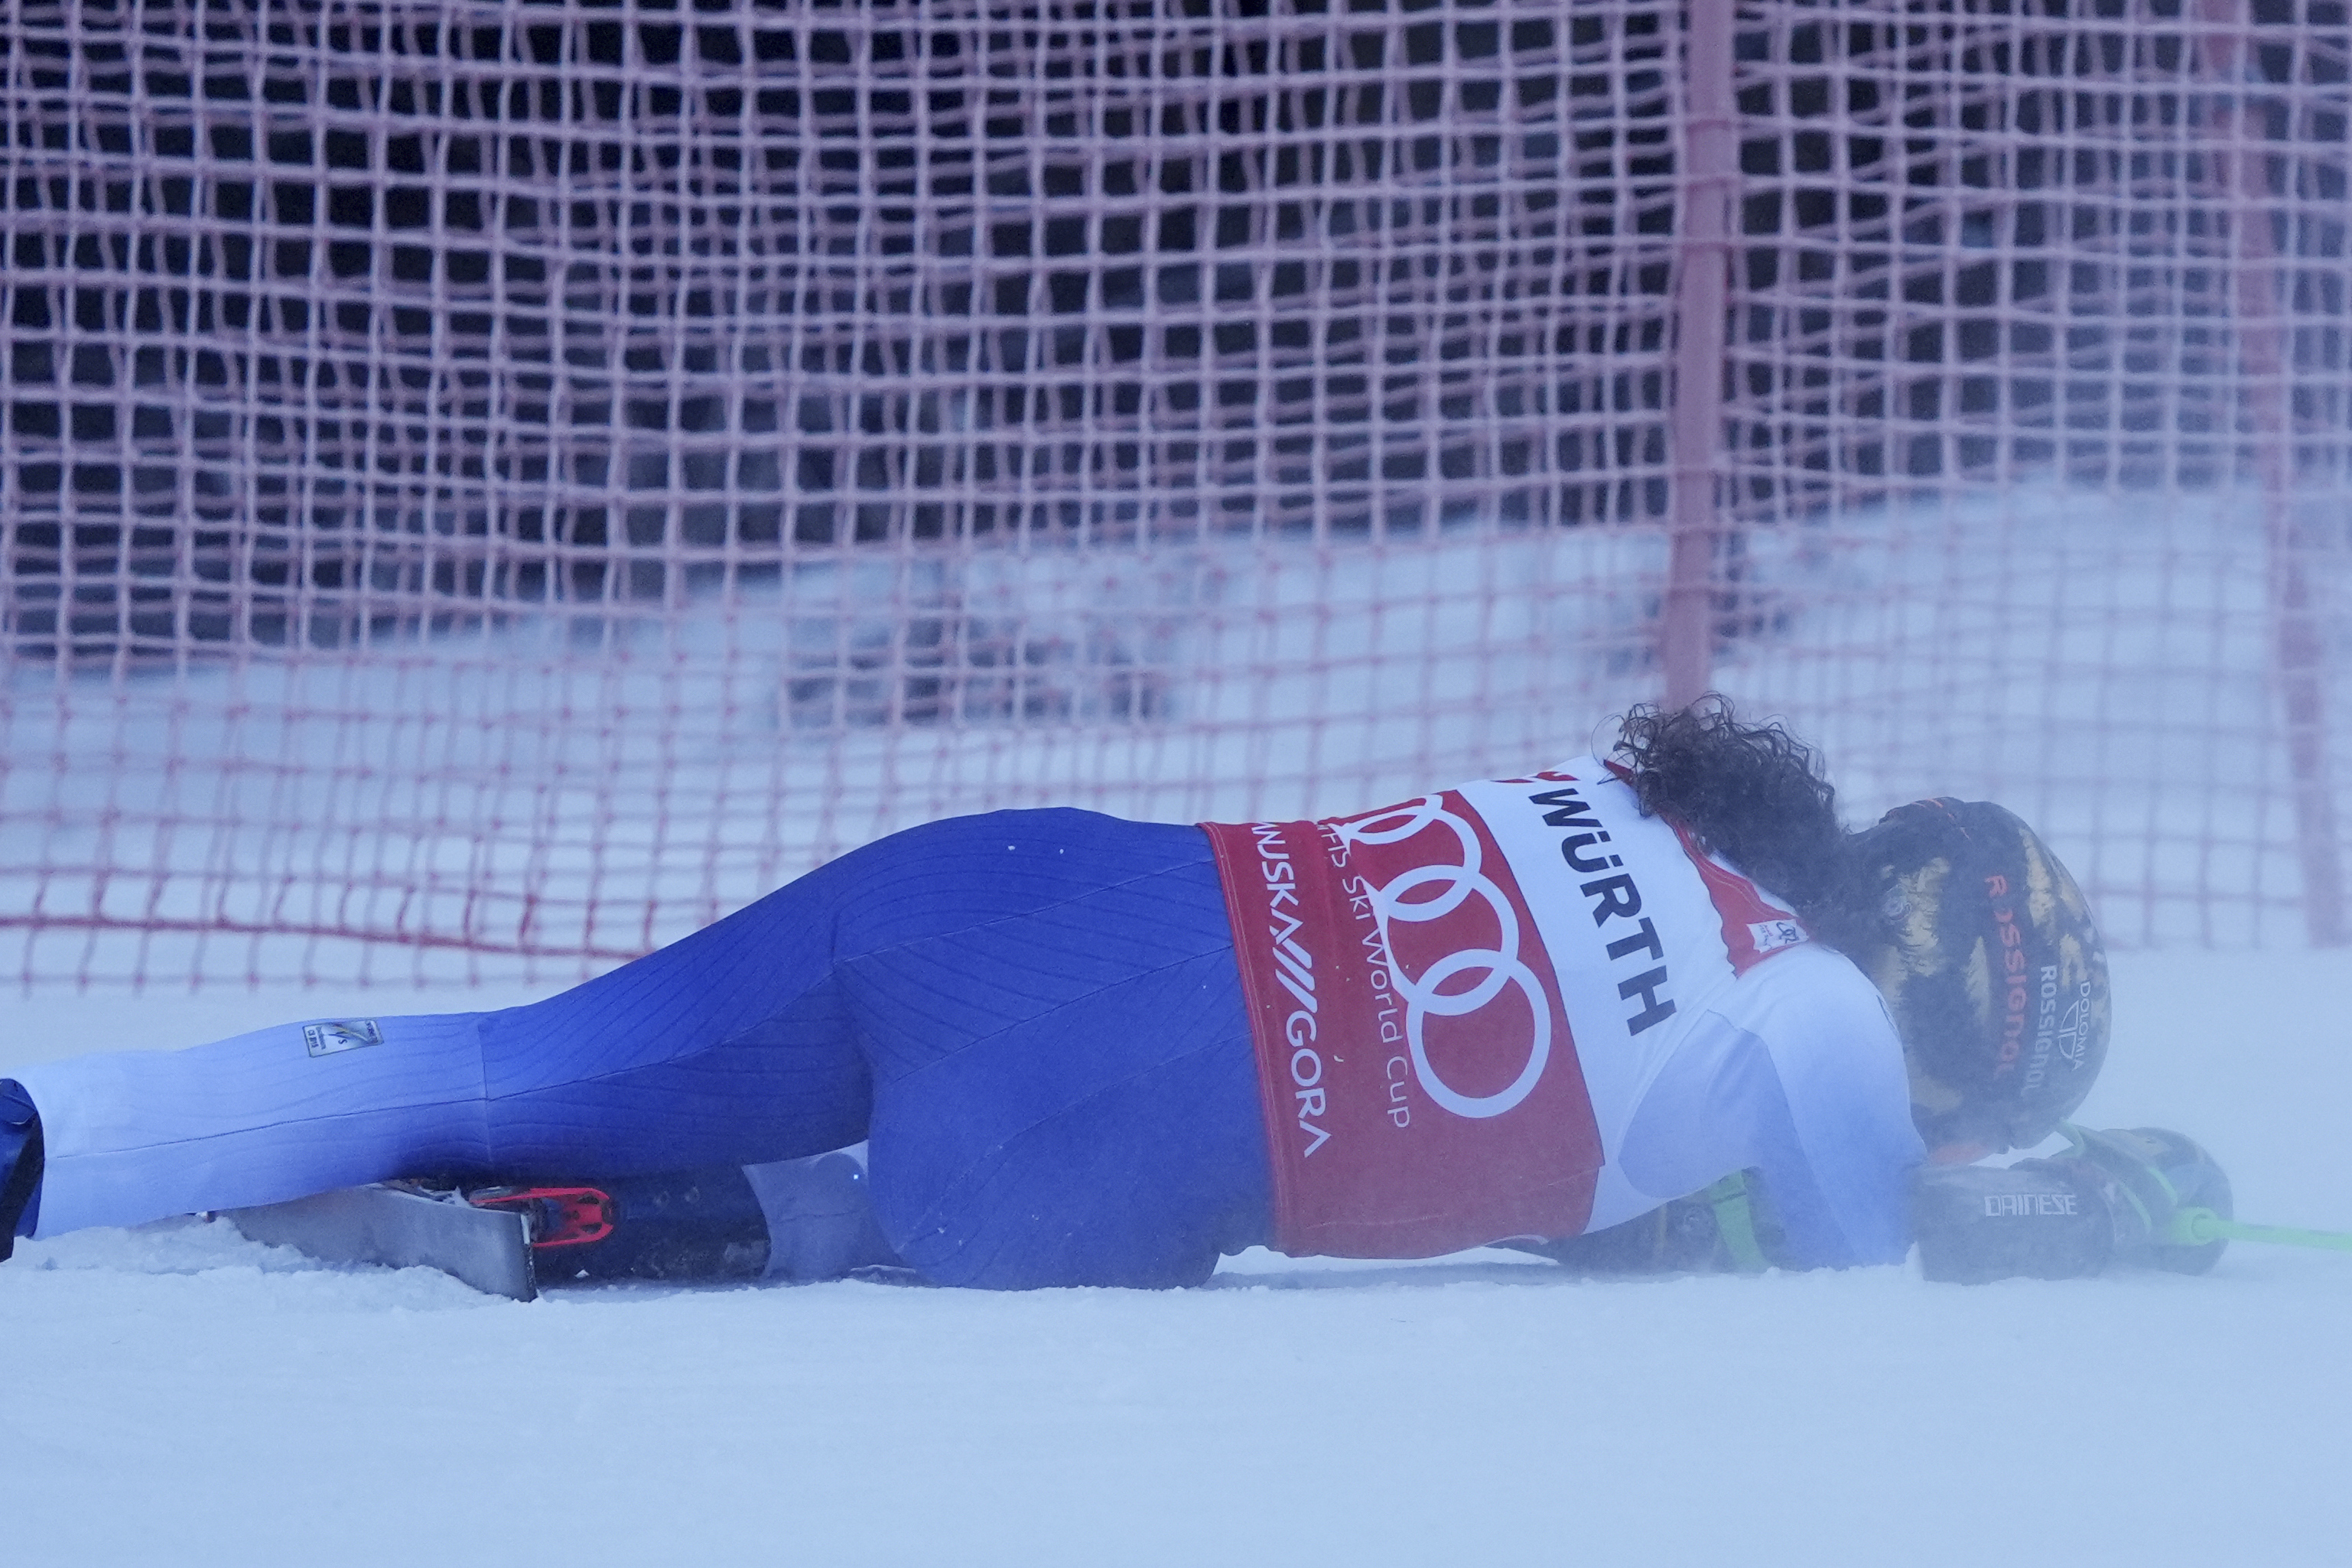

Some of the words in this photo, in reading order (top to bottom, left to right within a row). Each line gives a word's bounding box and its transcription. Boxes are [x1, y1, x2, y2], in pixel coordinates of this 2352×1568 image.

[1342, 876, 1374, 920] Ski
[1361, 928, 1404, 1043] World
[1385, 1056, 1410, 1128] Cup
[1528, 788, 1677, 1036] WÜRTH
[1287, 1010, 1332, 1157] GORA
[2072, 980, 2091, 1072] DOLOMIA
